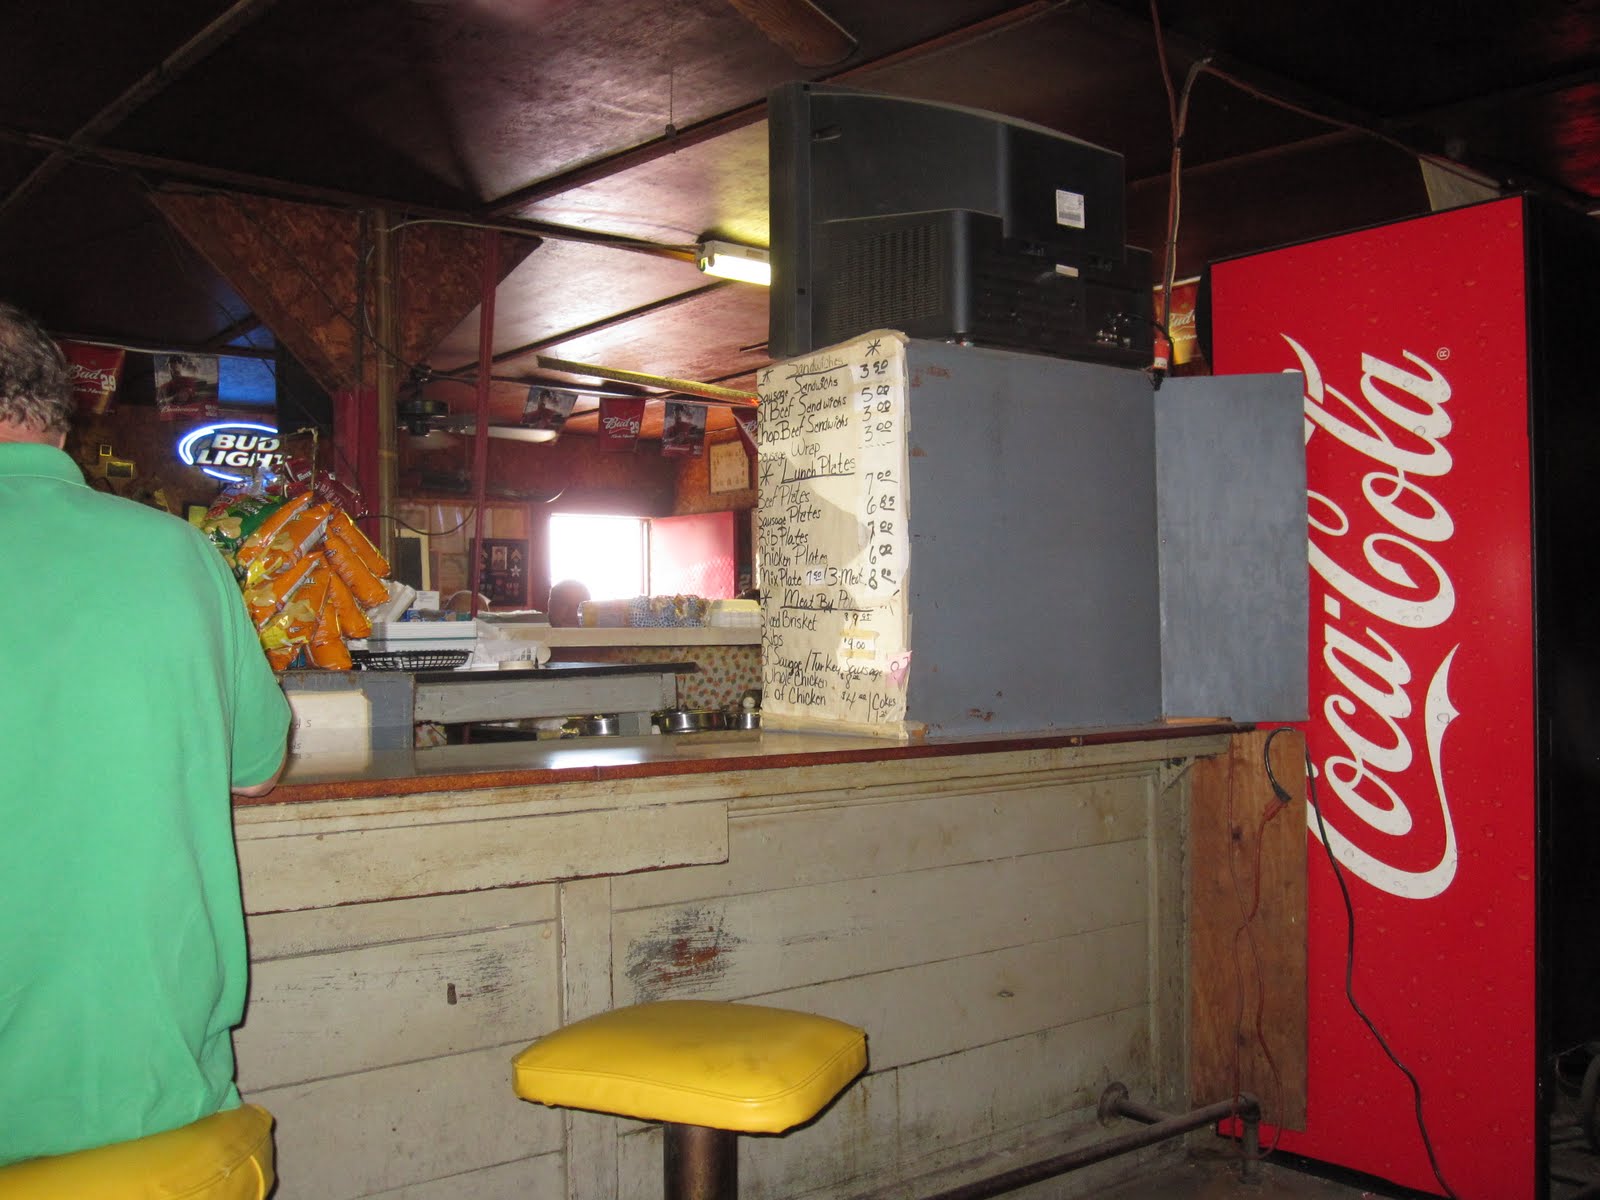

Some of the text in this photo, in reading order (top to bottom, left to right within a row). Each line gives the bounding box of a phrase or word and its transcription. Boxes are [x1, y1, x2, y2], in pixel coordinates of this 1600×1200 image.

[71, 364, 102, 380] Bud
[101, 374, 116, 392] 29
[770, 397, 795, 421] Beef
[603, 416, 631, 430] Bud
[775, 415, 805, 440] Beef
[211, 434, 281, 452] BUD
[791, 438, 821, 457] Wrap
[781, 452, 856, 484] Lunch Plates
[757, 485, 779, 510] Beef
[779, 482, 811, 506] Plates
[786, 504, 822, 523] Plates
[758, 527, 778, 546] Rib
[778, 526, 809, 546] Plates
[760, 567, 779, 587] Mix
[778, 567, 802, 587] Plate
[783, 589, 815, 609] Meat
[816, 593, 834, 613] By
[1280, 333, 1457, 900] Coca-Cola
[761, 627, 784, 647] Ribs
[789, 687, 826, 706] Chicken
[872, 693, 897, 711] Cokes
